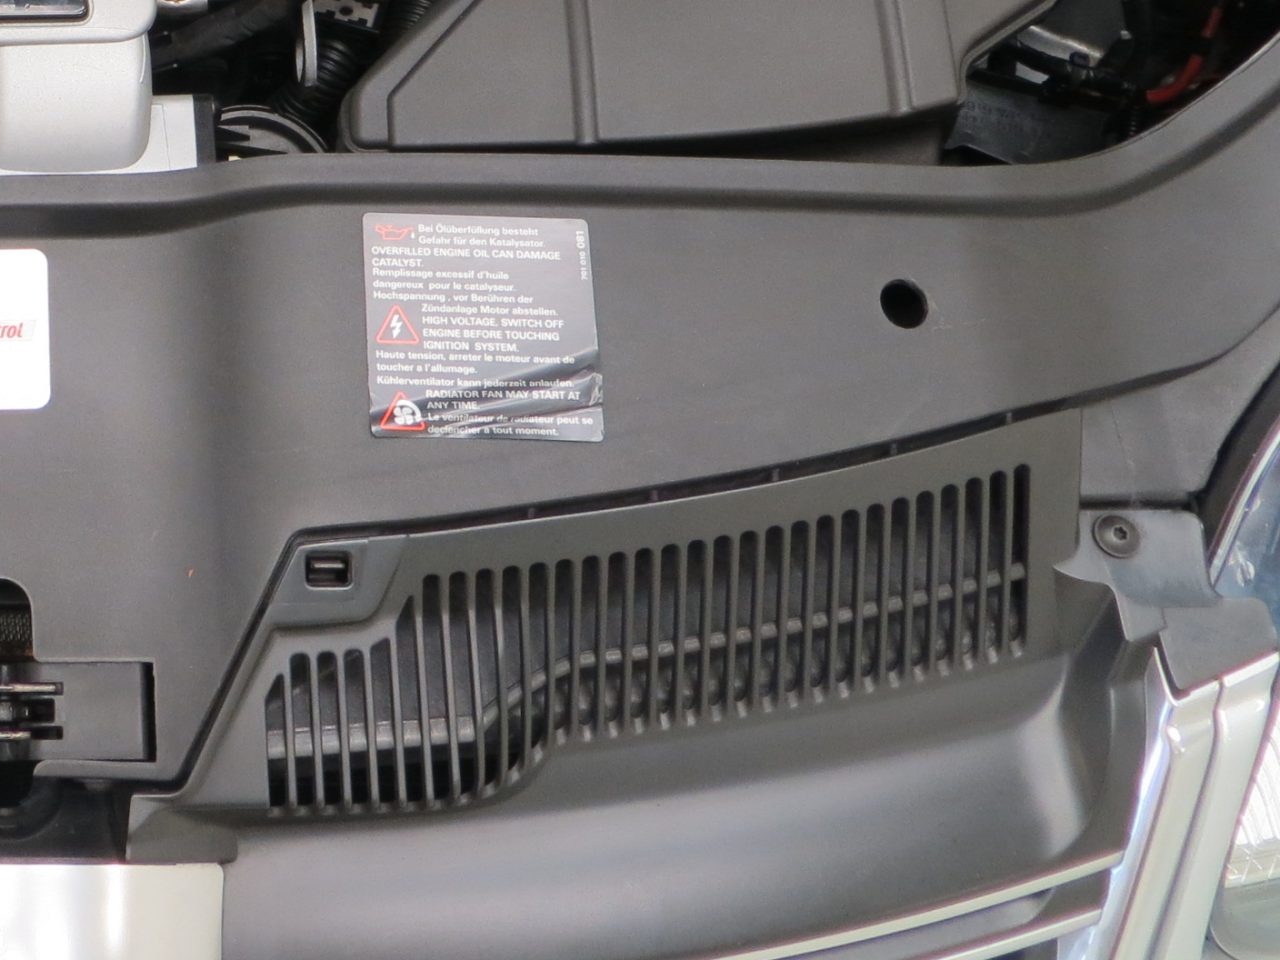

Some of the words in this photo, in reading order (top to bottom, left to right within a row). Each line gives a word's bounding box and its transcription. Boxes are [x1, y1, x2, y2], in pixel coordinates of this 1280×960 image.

[418, 224, 433, 233] Bei
[502, 227, 538, 236] besteht
[419, 236, 451, 245] Gefahr
[454, 237, 468, 246] für
[470, 238, 487, 246] den
[371, 246, 431, 256] OVERFILLED
[434, 248, 470, 257] ENGINE
[473, 249, 490, 258] OIL
[492, 249, 513, 258] CAN
[516, 250, 561, 260] DAMAGE
[373, 268, 433, 279] Remplissage
[436, 269, 474, 279] excessif
[477, 271, 509, 280] d'huile
[373, 280, 423, 290] dangereux
[429, 283, 450, 291] pour
[453, 281, 462, 290] le
[453, 294, 468, 302] vor
[471, 293, 515, 303] Berühren
[517, 294, 533, 303] der
[422, 304, 478, 316] Zündanlage
[480, 305, 509, 315] Motor
[422, 317, 448, 325] HIGH
[501, 318, 542, 328] SWITCH
[544, 320, 565, 329] OFF
[423, 328, 461, 338] ENGINE
[463, 330, 503, 340] BEFORE
[505, 330, 560, 341] TOUCHING
[423, 341, 469, 351] IGNITION
[376, 350, 405, 359] Haute
[484, 353, 493, 362] le
[495, 355, 531, 363] moteur
[533, 355, 559, 363] avant
[561, 355, 575, 364] de
[377, 363, 414, 372] toucher
[377, 375, 455, 387] Kühlerventilator
[457, 378, 482, 387] kann
[483, 378, 526, 388] jederzeit
[426, 389, 479, 398] RADIATOR
[481, 390, 503, 399] FAN
[505, 390, 530, 399] MAY
[532, 390, 565, 400] START
[567, 391, 581, 400] AT
[427, 401, 450, 410] ANY
[428, 413, 440, 421] Le
[496, 414, 509, 423] de
[557, 415, 580, 425] peut
[582, 416, 593, 425] se
[492, 426, 513, 434] tout
